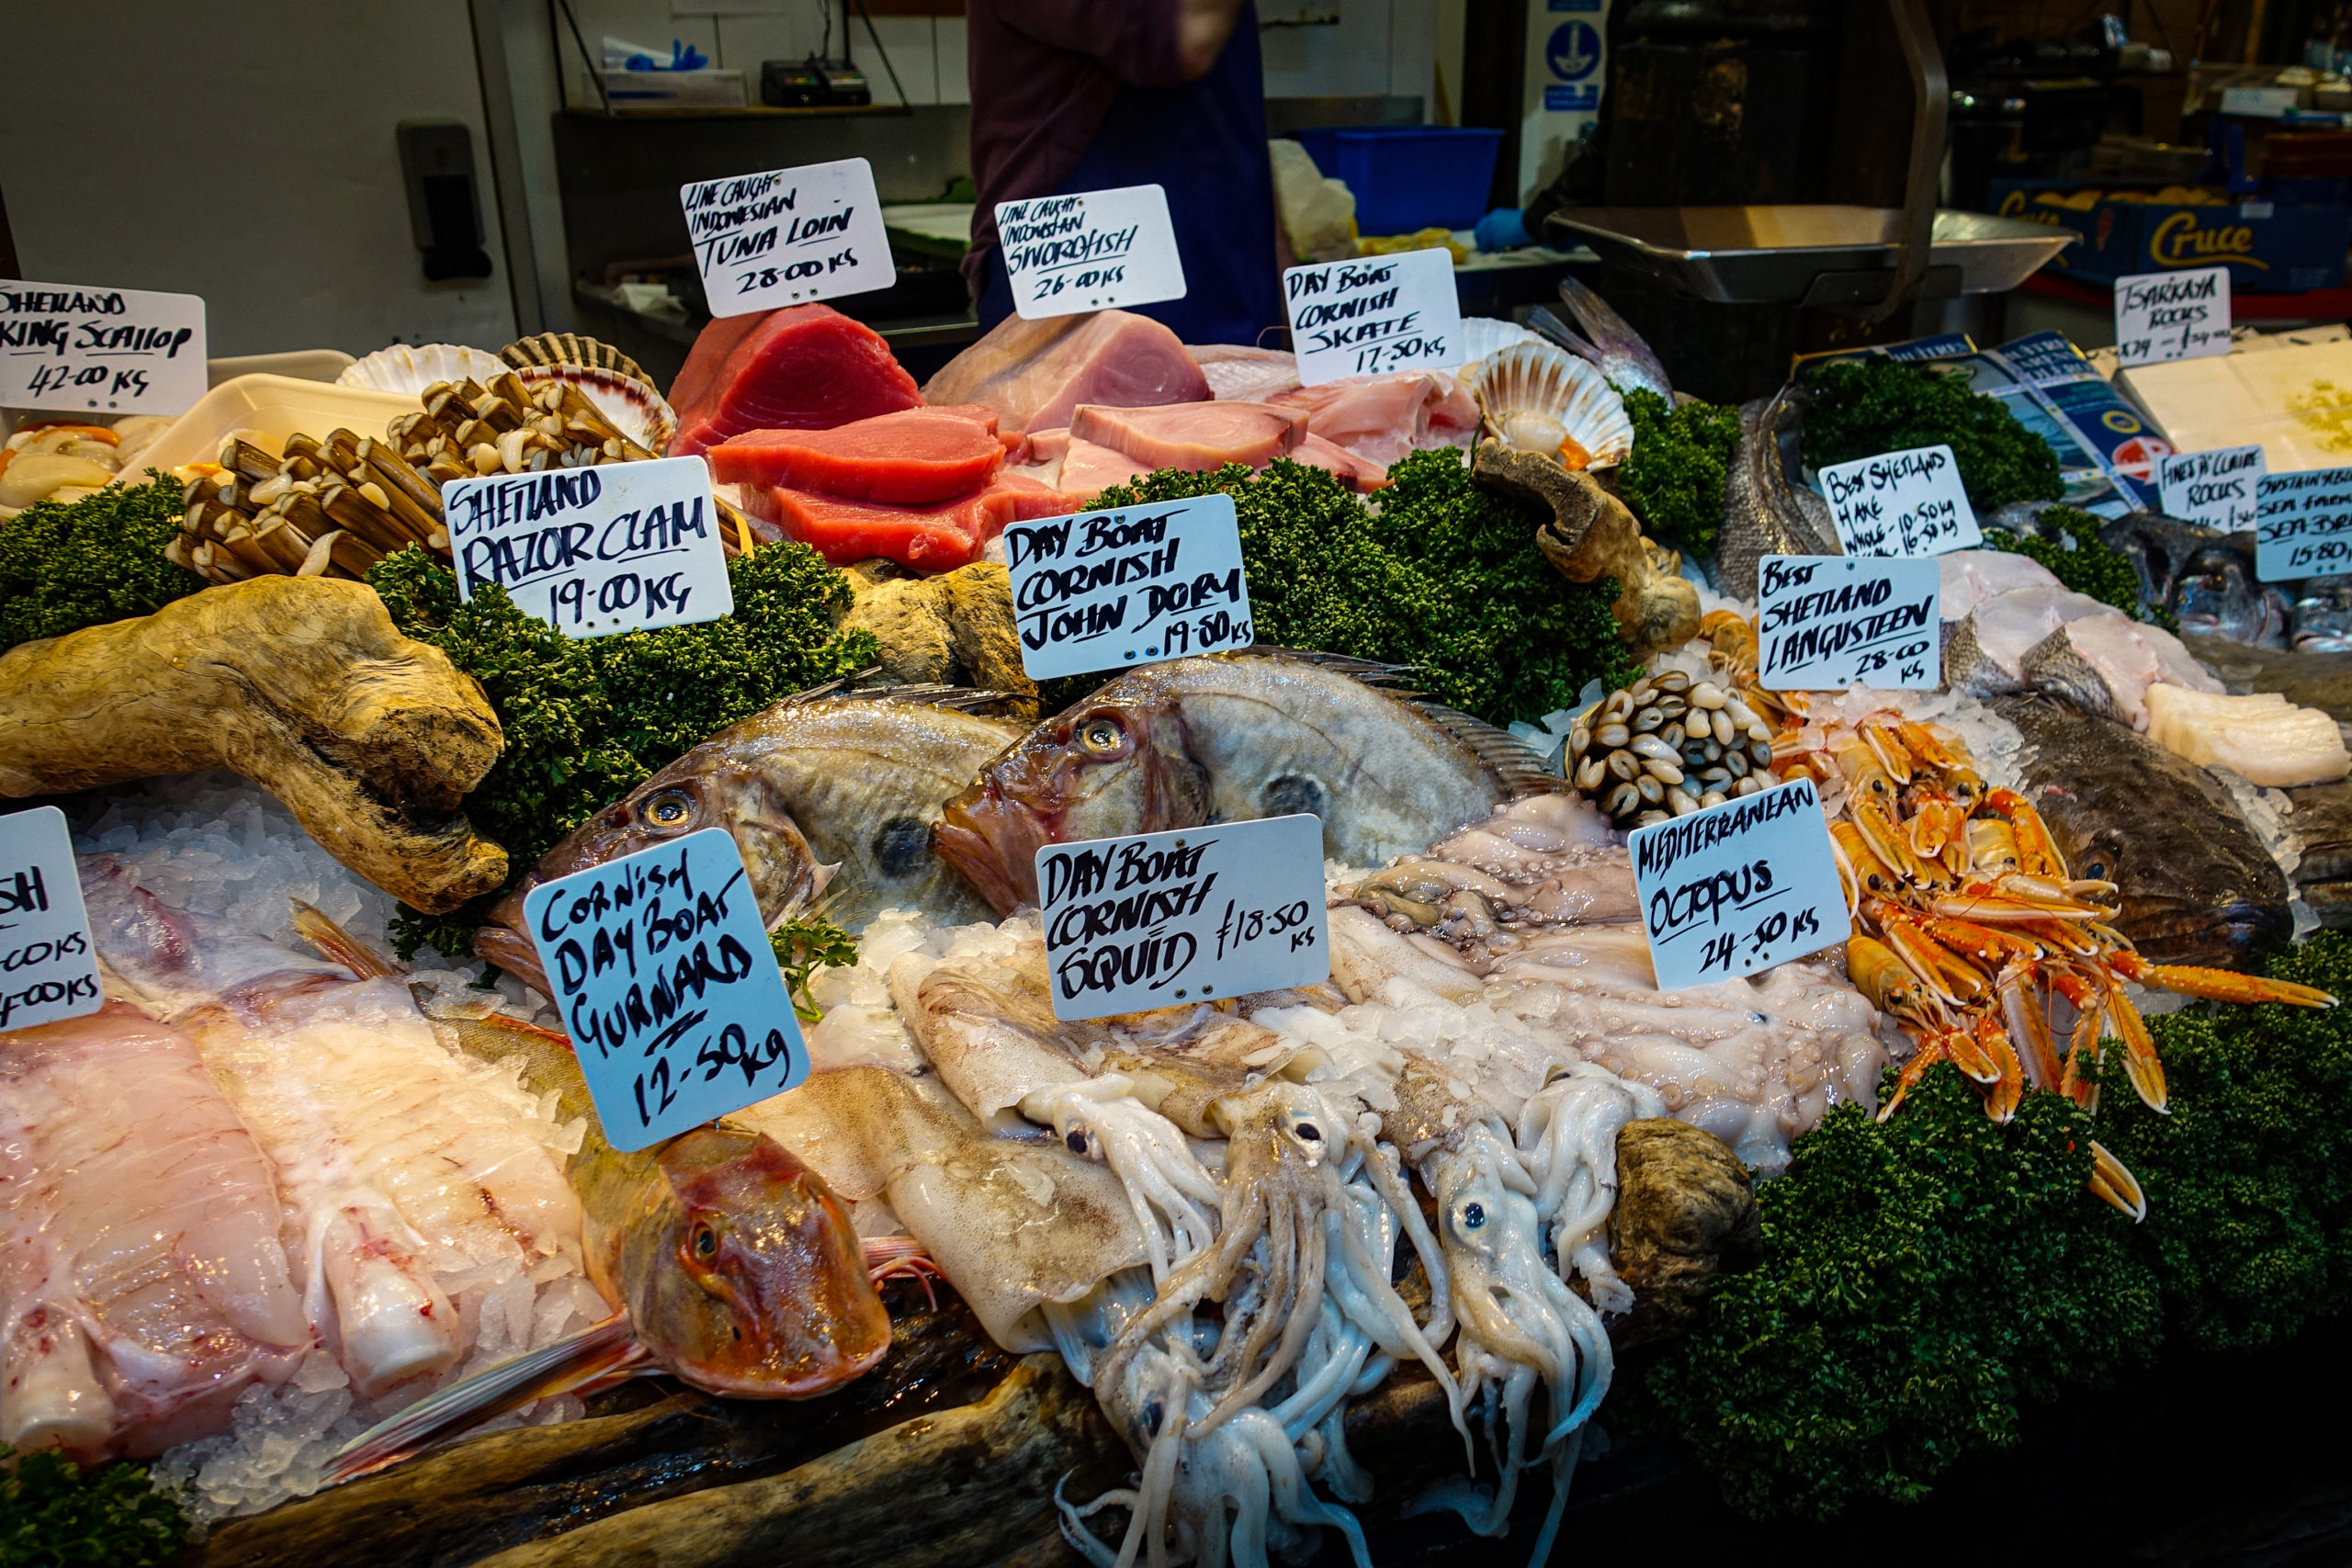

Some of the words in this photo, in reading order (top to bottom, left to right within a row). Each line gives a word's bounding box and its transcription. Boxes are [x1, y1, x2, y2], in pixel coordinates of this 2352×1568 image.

[721, 172, 784, 207] CAUGHT
[695, 227, 778, 278] TUNA
[786, 207, 854, 245] LOIN
[1009, 225, 1138, 276] SWORDFISH
[2150, 211, 2260, 267] Cruce
[1286, 266, 1330, 301] DAY
[1295, 287, 1399, 331] CORNISH
[0, 320, 69, 356] KING
[1305, 310, 1420, 355] SKATE
[449, 469, 602, 536] SHETLAND
[1838, 495, 1883, 536] HAKE
[461, 523, 594, 596] RAZOR
[597, 496, 707, 561] CLAM
[1004, 519, 1073, 572] DAY
[1075, 508, 1191, 558] BOAT
[1017, 537, 1181, 612] CORNISH
[1761, 559, 1823, 598] BEST
[1761, 578, 1893, 633] SHETLAND
[1017, 595, 1128, 651] JOHN
[1131, 568, 1241, 633] DORY
[1638, 782, 1814, 882] MEDITERRANEAN
[1042, 844, 1117, 911] DAY
[1114, 839, 1220, 891] BOAT
[1650, 860, 1773, 938] OCTOPUS
[554, 919, 637, 996] DAY
[643, 867, 744, 955] BOAT
[1046, 872, 1219, 952] CORNISH
[571, 933, 752, 1059] GURNARD
[1057, 931, 1197, 999] SQUID
